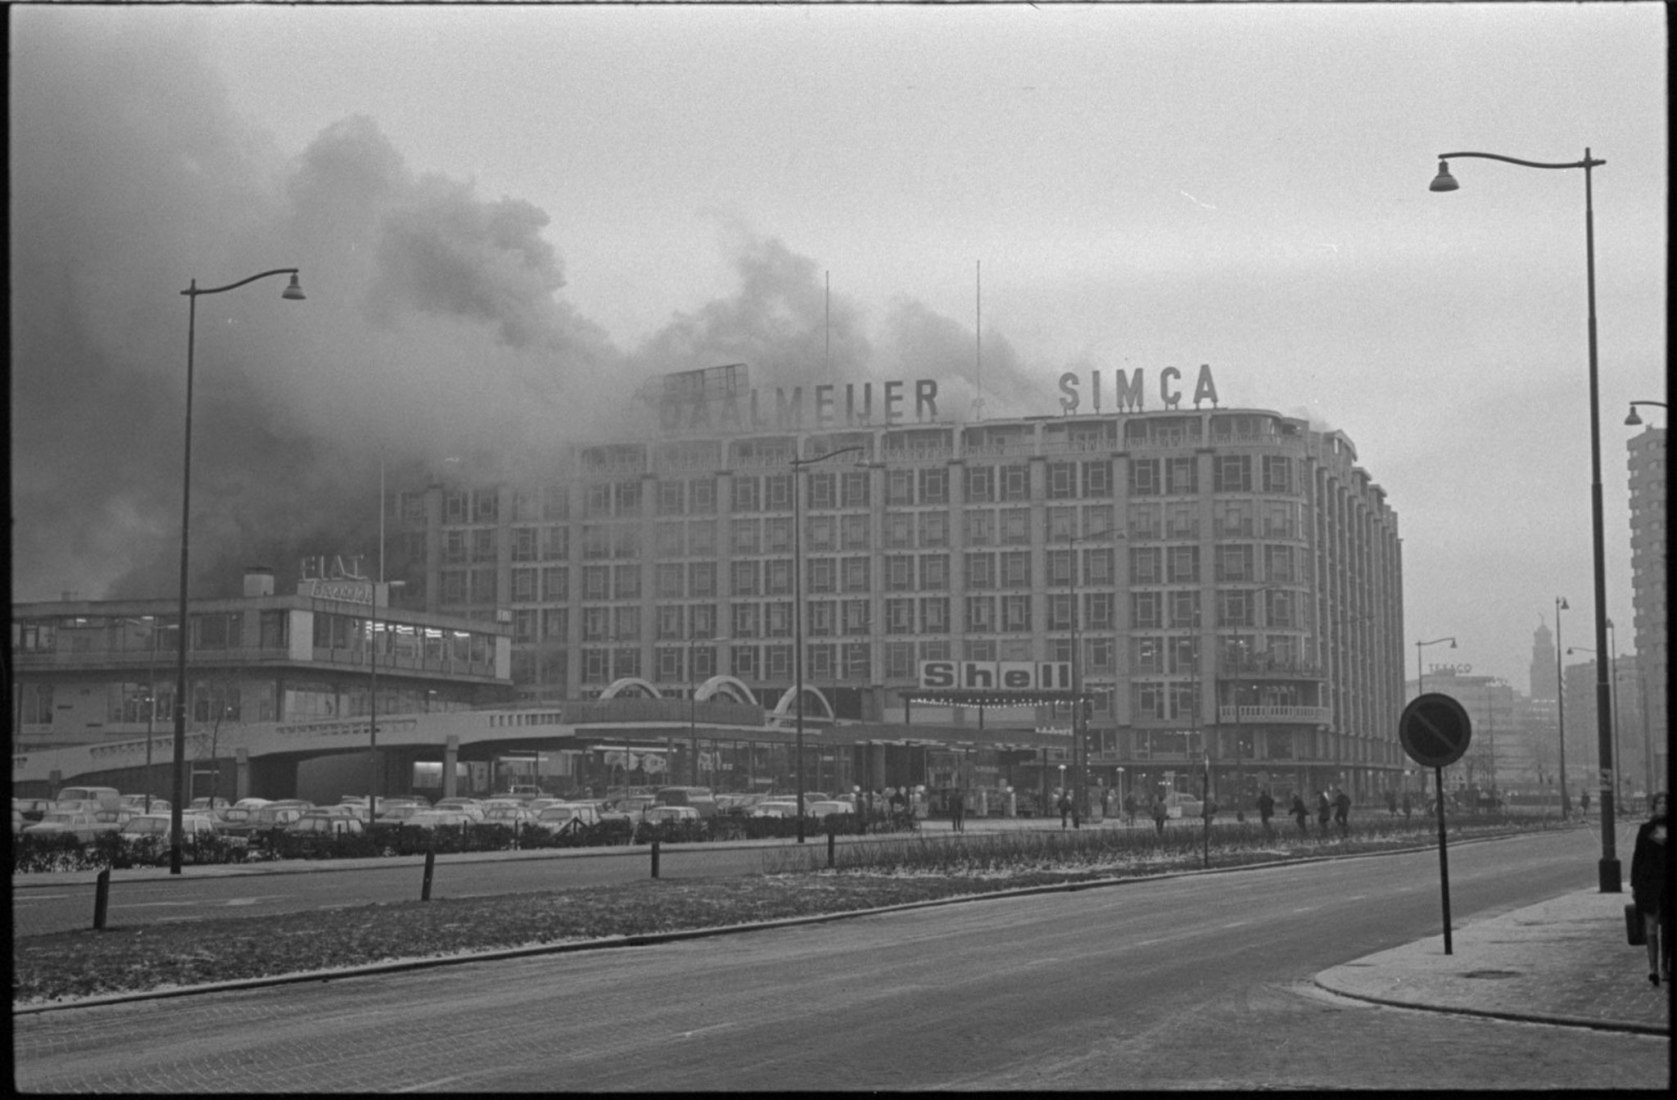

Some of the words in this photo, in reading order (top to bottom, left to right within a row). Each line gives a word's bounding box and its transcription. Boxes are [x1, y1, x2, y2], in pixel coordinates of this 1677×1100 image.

[1058, 364, 1218, 408] SIMCA
[299, 553, 364, 580] FIAT
[924, 662, 1069, 688] Shell
